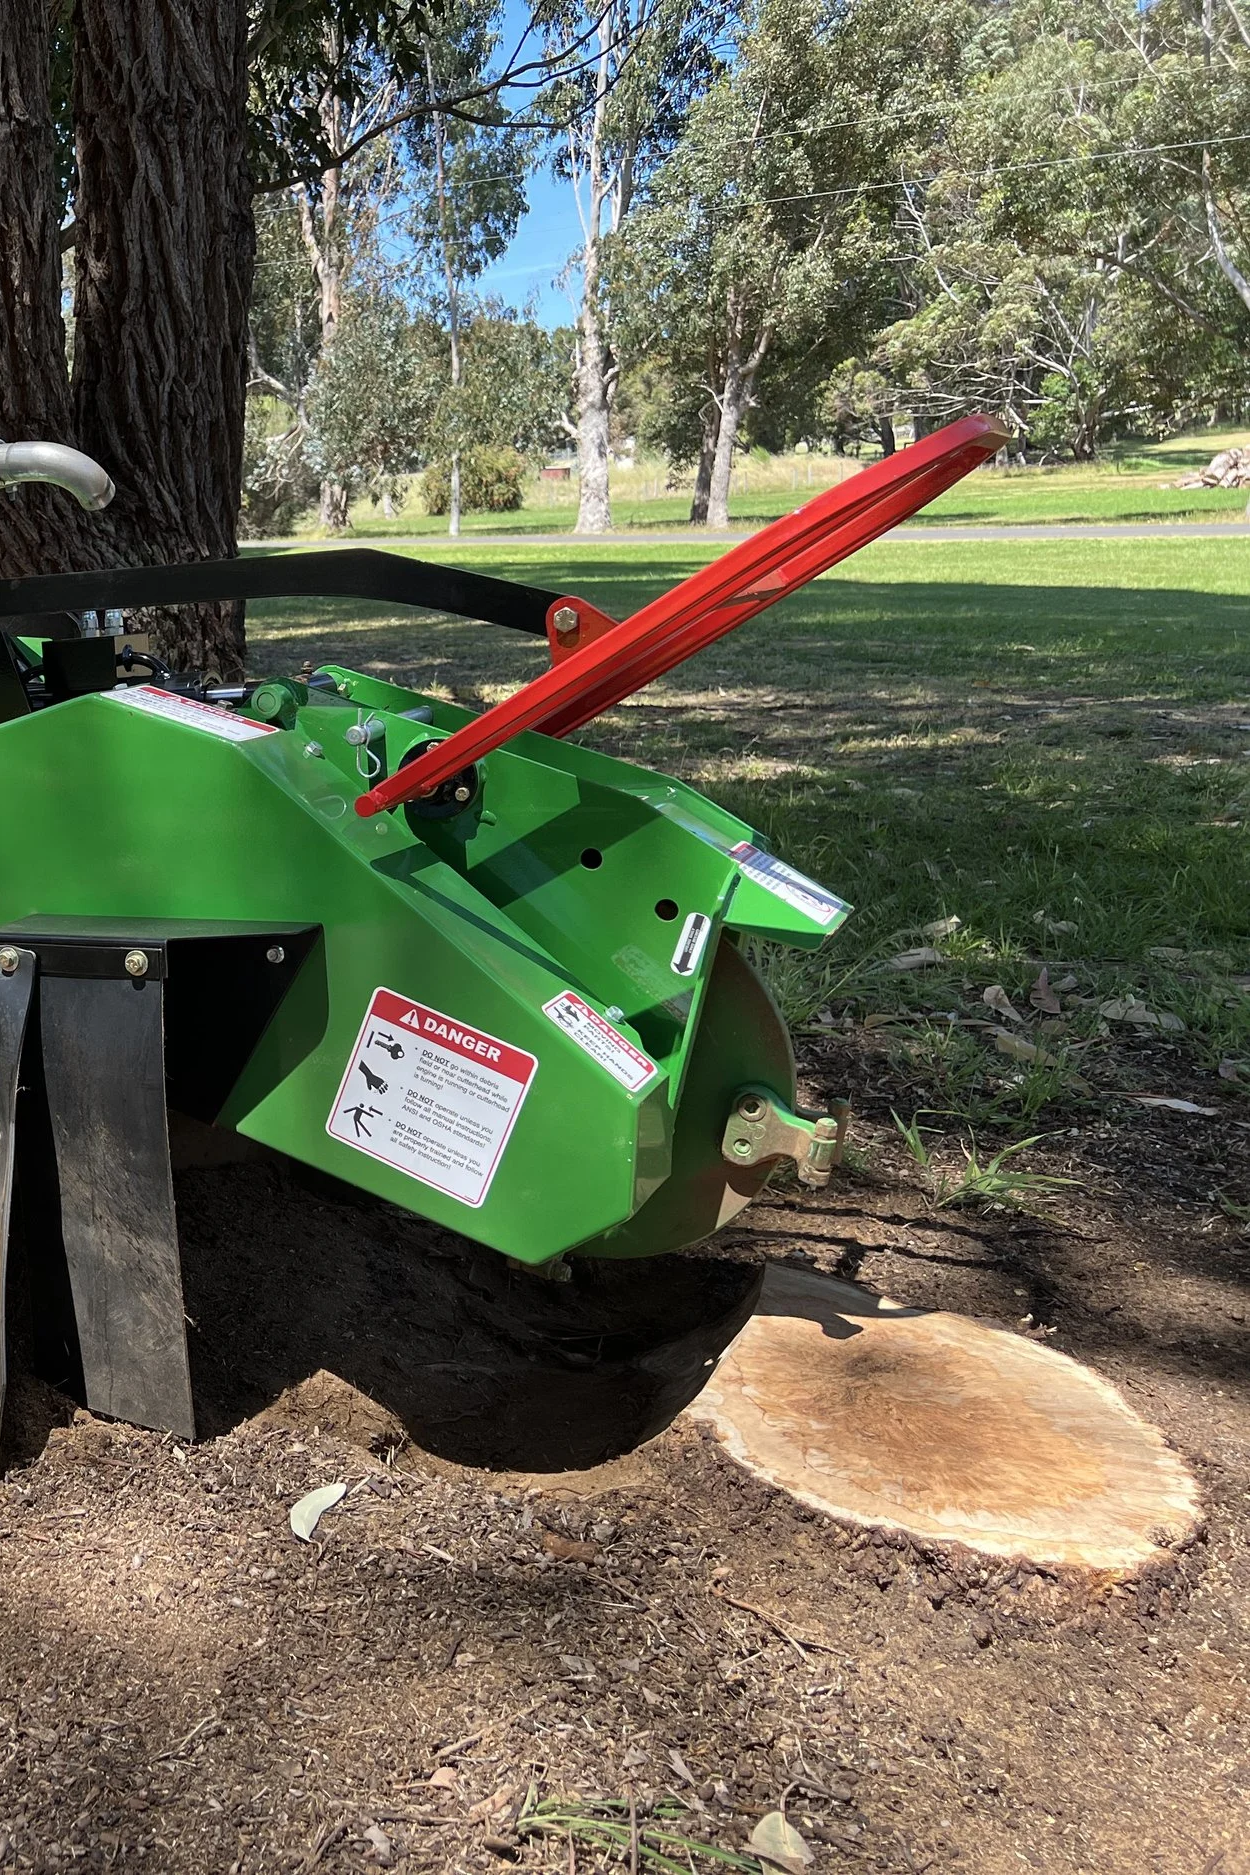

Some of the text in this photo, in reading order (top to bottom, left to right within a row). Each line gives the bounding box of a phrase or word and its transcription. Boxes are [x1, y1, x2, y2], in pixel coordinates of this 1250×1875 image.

[185, 700, 246, 723] DANGER
[424, 1016, 502, 1063] DANGER
[573, 1031, 607, 1062] CLEAR!
[578, 1029, 633, 1081] KEEP HANDS
[583, 1025, 615, 1053] PARTS!
[586, 1021, 622, 1054] MOVING
[589, 1014, 648, 1068] DANGER
[416, 1065, 436, 1078] engine
[444, 1078, 468, 1093] running
[476, 1090, 510, 1113] cutterhead
[419, 1057, 432, 1067] field
[441, 1068, 456, 1078] near
[457, 1075, 490, 1094] cutterhead
[490, 1089, 508, 1103] while
[419, 1075, 443, 1090] turning!
[422, 1049, 499, 1089] DO NOT go within debris
[401, 1104, 418, 1115] ANSI
[419, 1112, 431, 1121] and
[432, 1119, 452, 1131] OSHA
[404, 1096, 422, 1108] follow
[431, 1109, 455, 1124] manual
[407, 1089, 493, 1135] DO NOT operate unless you
[395, 1121, 480, 1167] DO NOT operate unless you
[398, 1140, 417, 1153] safety
[403, 1135, 428, 1150] properly
[429, 1147, 451, 1161] trained
[452, 1158, 464, 1167] and
[465, 1164, 484, 1177] follow
